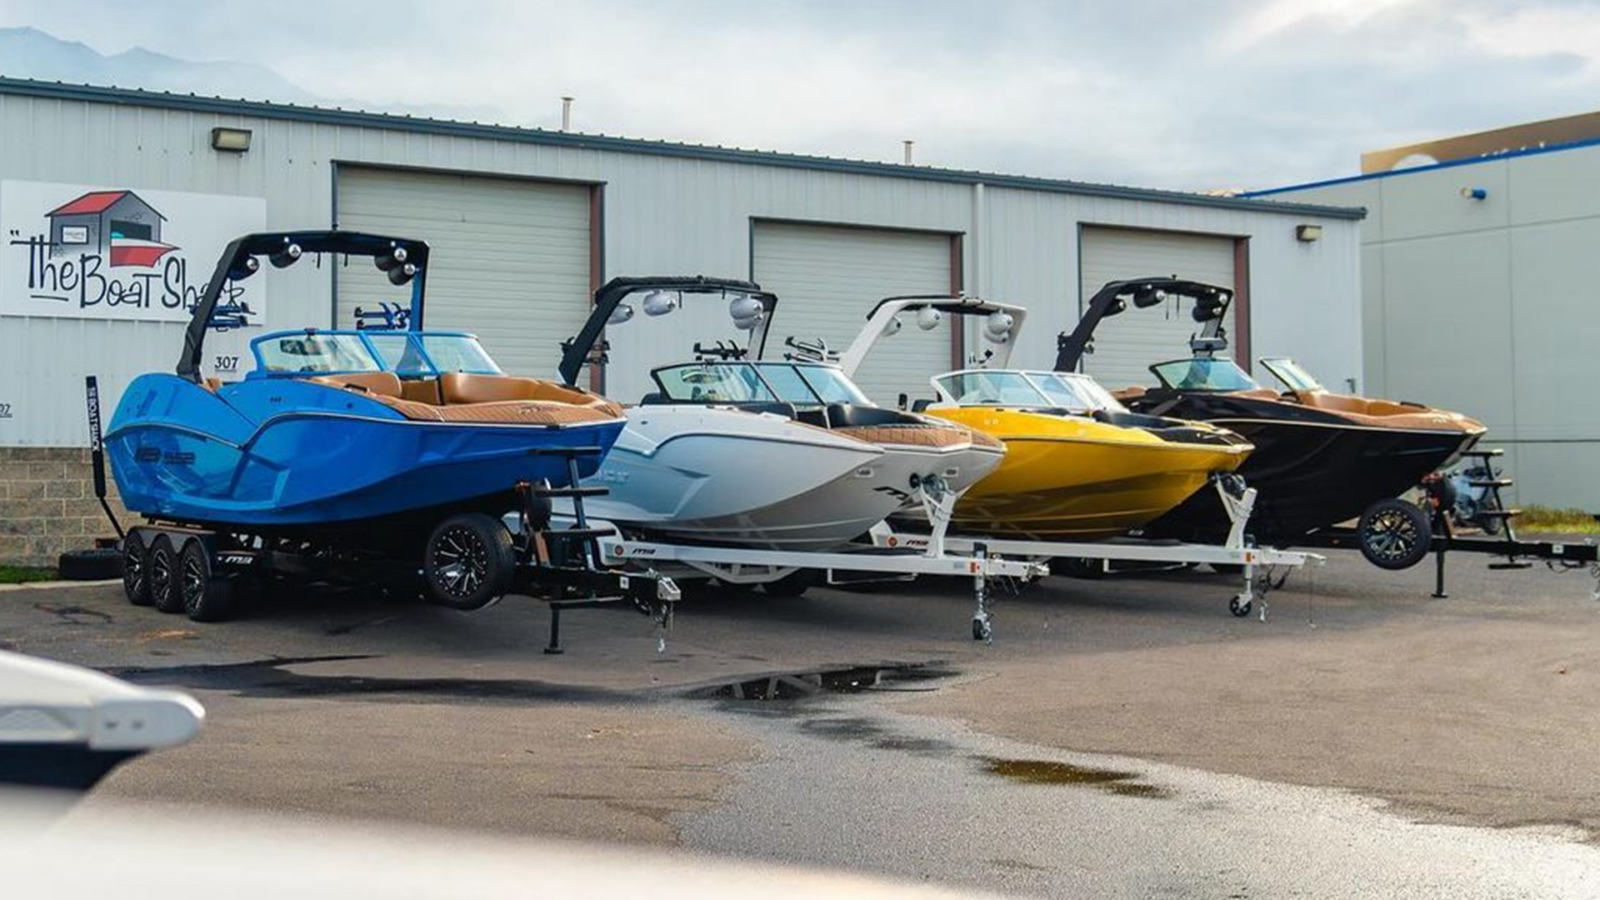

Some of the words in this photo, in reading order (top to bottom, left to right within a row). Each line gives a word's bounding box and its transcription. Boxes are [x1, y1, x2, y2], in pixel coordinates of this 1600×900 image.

[161, 256, 245, 310] Shk
[214, 356, 239, 369] 307
[88, 398, 99, 423] BOAT
